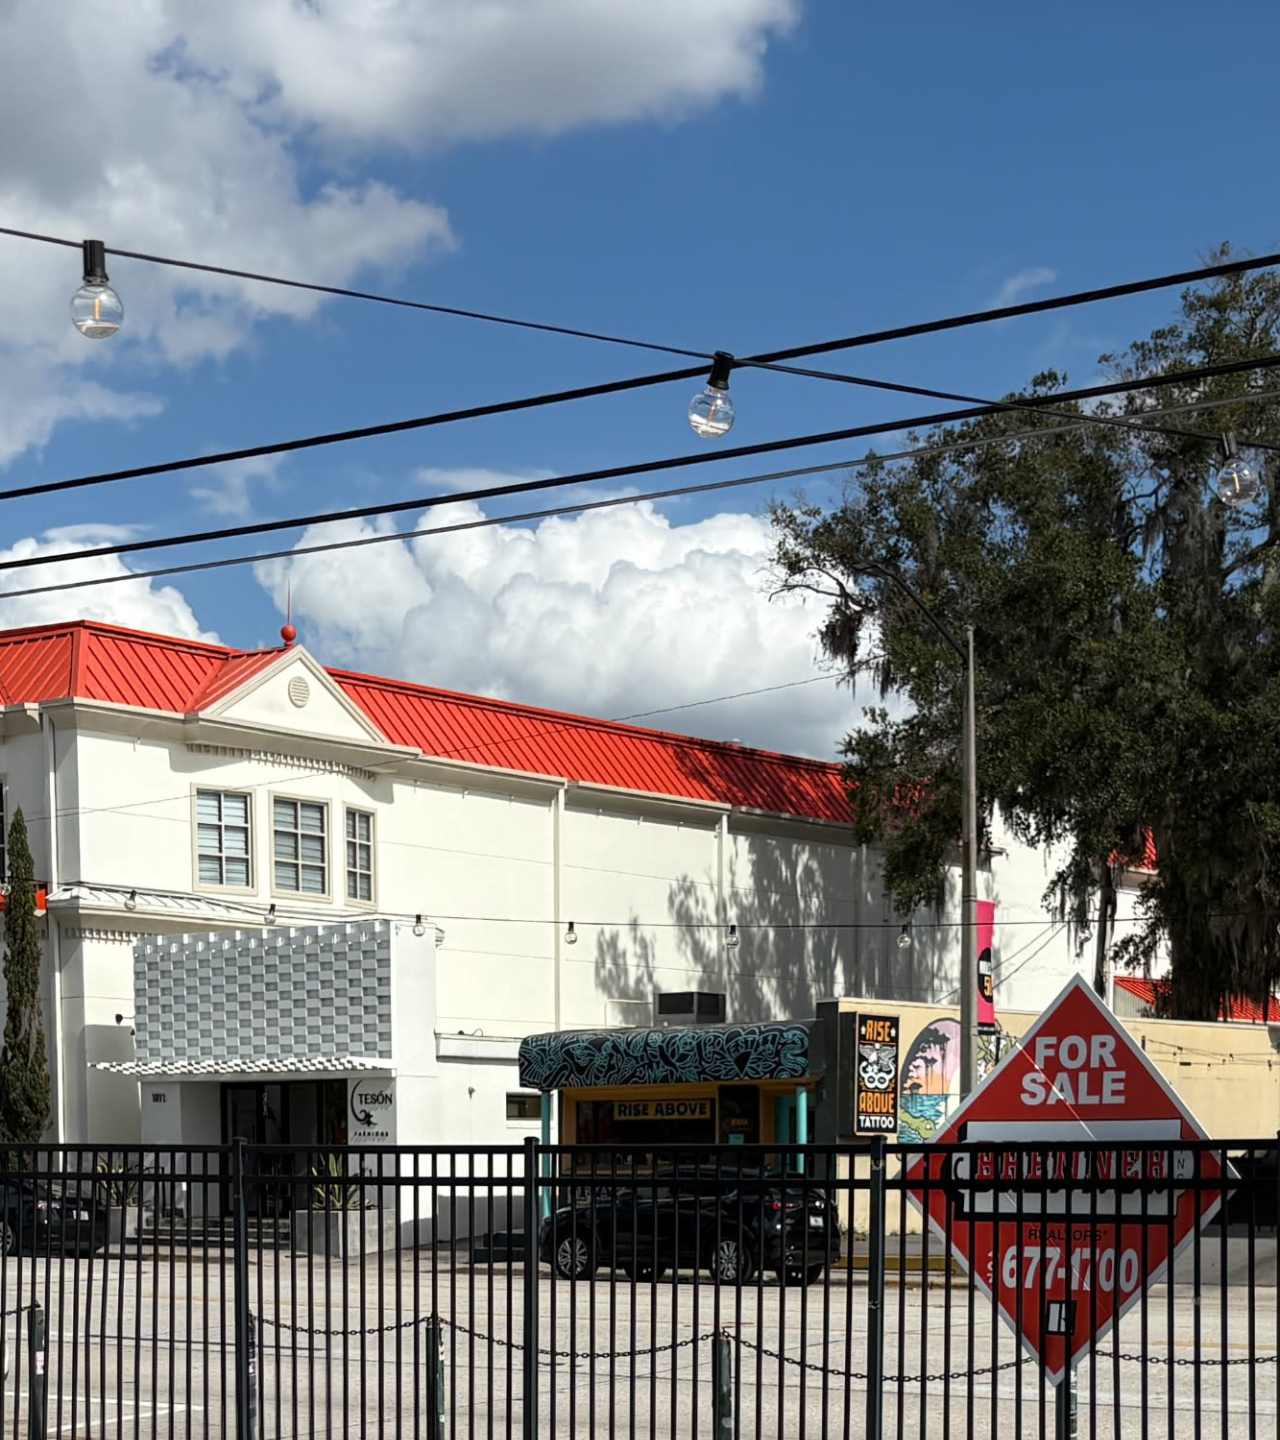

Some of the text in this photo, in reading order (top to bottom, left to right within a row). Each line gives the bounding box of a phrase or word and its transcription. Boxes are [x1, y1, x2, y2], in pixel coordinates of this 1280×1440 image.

[866, 1020, 891, 1041] RISE
[1034, 1035, 1116, 1070] FOR
[1021, 1071, 1125, 1106] SALE
[618, 1102, 707, 1116] RISE ABOVE
[859, 1116, 895, 1129] TATTOO
[1002, 1245, 1139, 1292] 677-1700
